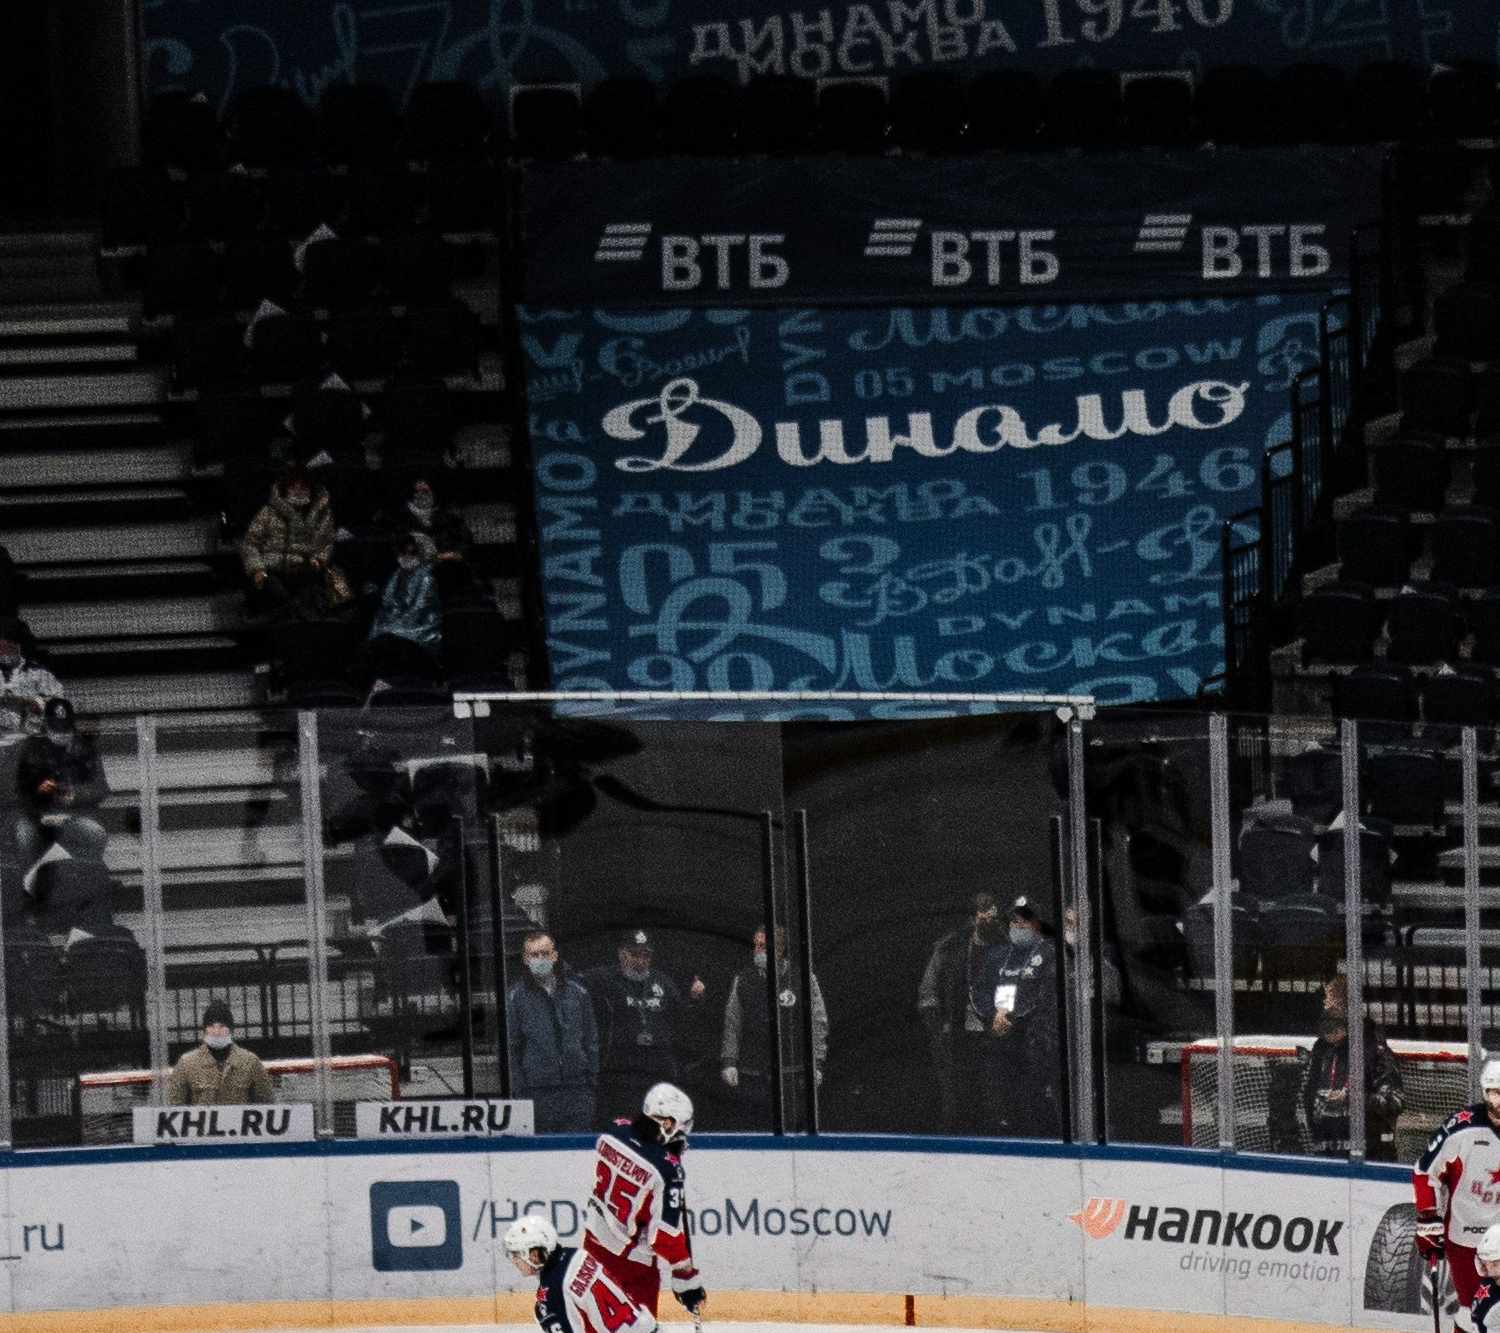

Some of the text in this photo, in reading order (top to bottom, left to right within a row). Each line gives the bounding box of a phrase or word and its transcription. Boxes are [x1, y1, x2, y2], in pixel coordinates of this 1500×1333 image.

[661, 223, 1332, 290] ВТБ ВТБ ВТБ
[930, 337, 1243, 394] MOSCOW
[601, 376, 1251, 474] Динамо
[1017, 446, 1256, 513] 1946
[938, 589, 1222, 637] DYNAM
[156, 1109, 291, 1139] KHL.RU
[379, 1105, 513, 1135] KHL.RU
[1180, 1250, 1341, 1283] driving emotion
